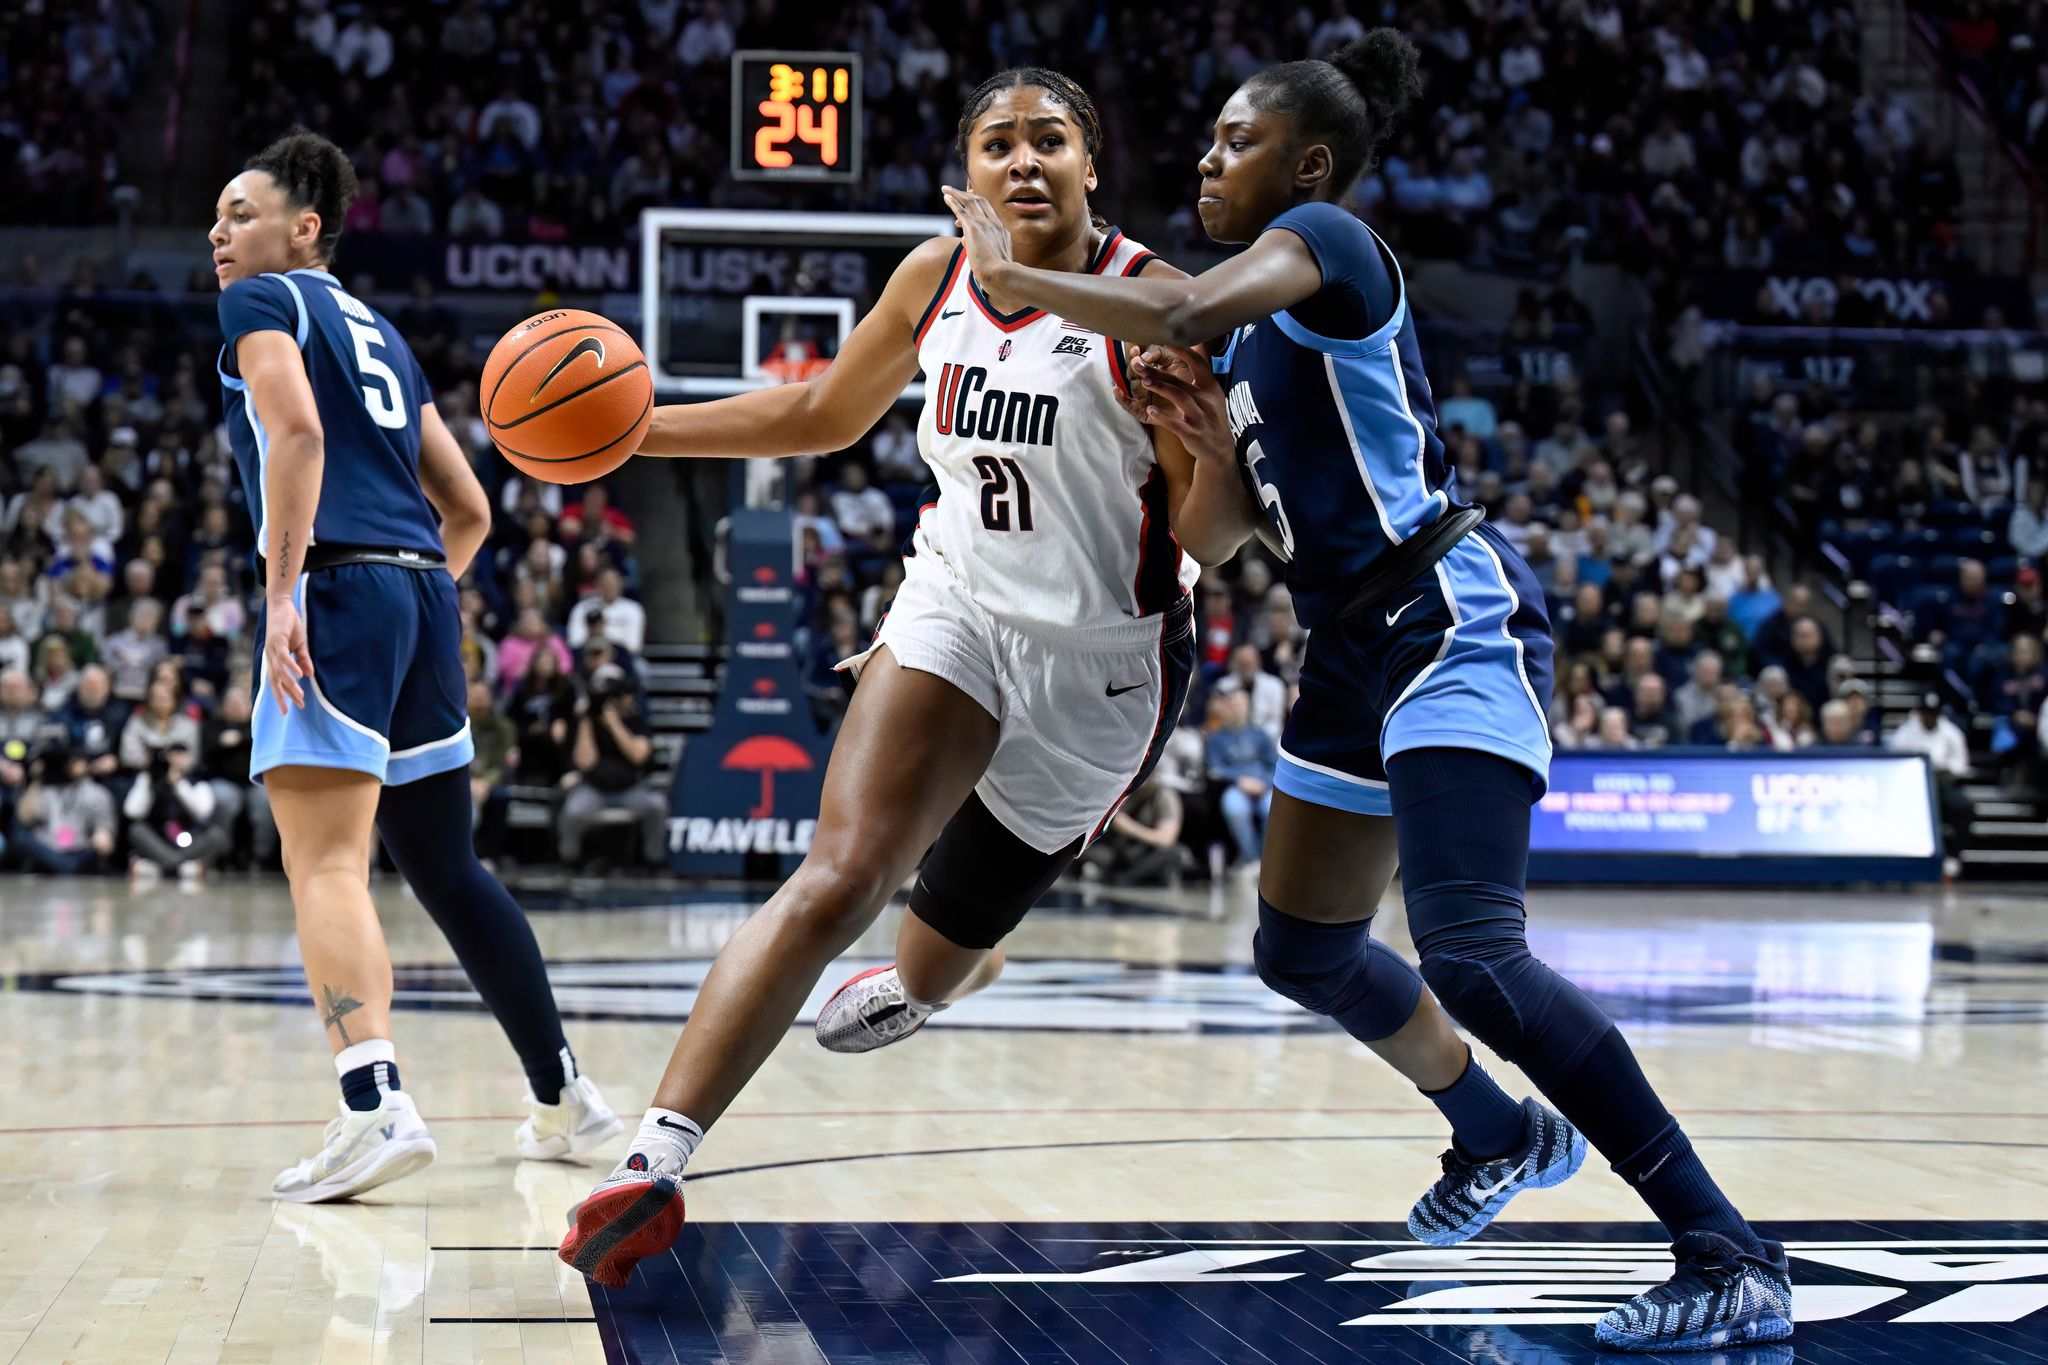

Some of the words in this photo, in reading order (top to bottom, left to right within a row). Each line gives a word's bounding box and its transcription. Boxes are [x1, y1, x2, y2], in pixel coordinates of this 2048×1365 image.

[769, 64, 849, 103] 3:11
[755, 101, 838, 168] 24
[446, 244, 628, 289] UCONN
[1055, 342, 1092, 354] EAST
[1060, 335, 1088, 346] BIG
[344, 316, 408, 429] 5
[936, 362, 1059, 446] UConn
[1225, 380, 1265, 448] ANOVA
[972, 455, 1034, 531] 21
[666, 817, 818, 855] TRAVELE
[932, 1248, 2048, 1283] AST
